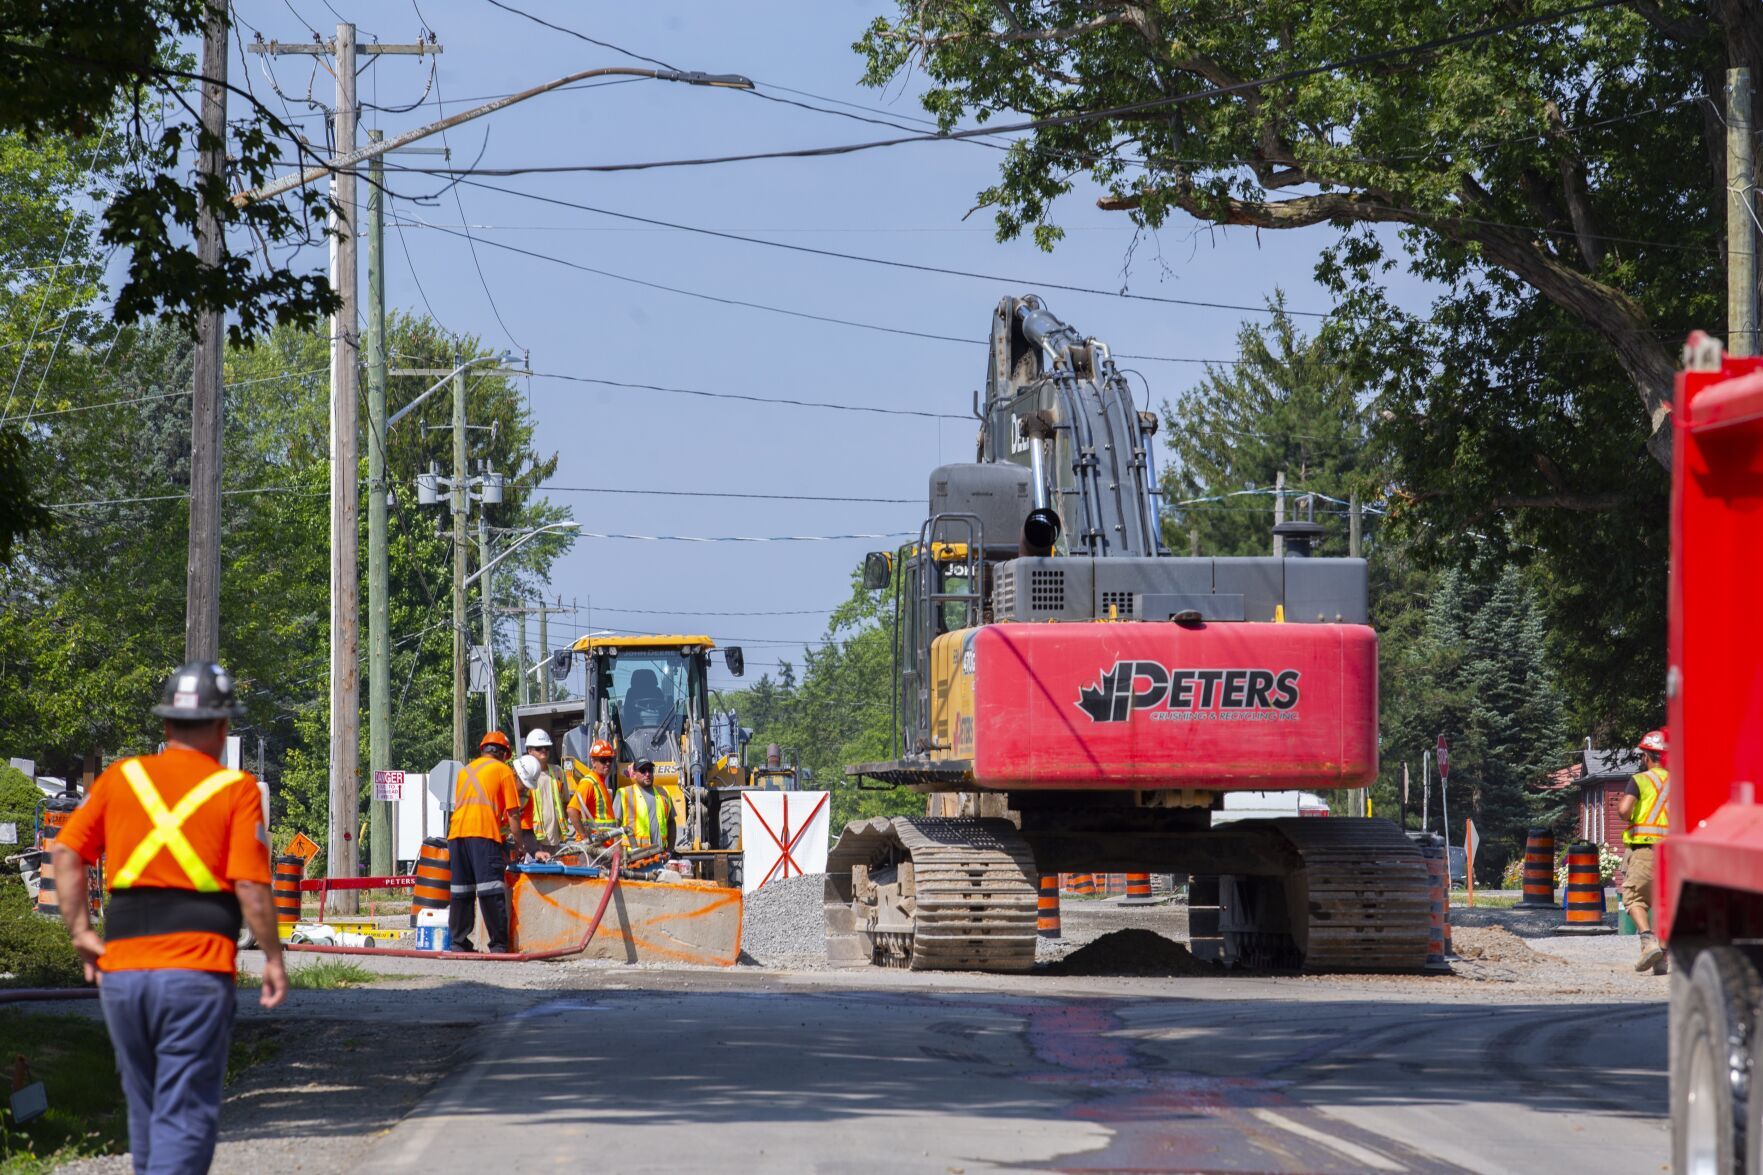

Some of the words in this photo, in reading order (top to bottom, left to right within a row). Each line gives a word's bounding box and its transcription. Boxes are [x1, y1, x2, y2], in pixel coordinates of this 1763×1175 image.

[1109, 660, 1301, 722] PETERS
[1150, 711, 1207, 721] CRUSHING
[1209, 711, 1216, 721] &
[1219, 711, 1277, 721] RECYCLING
[375, 771, 403, 784] DANGER
